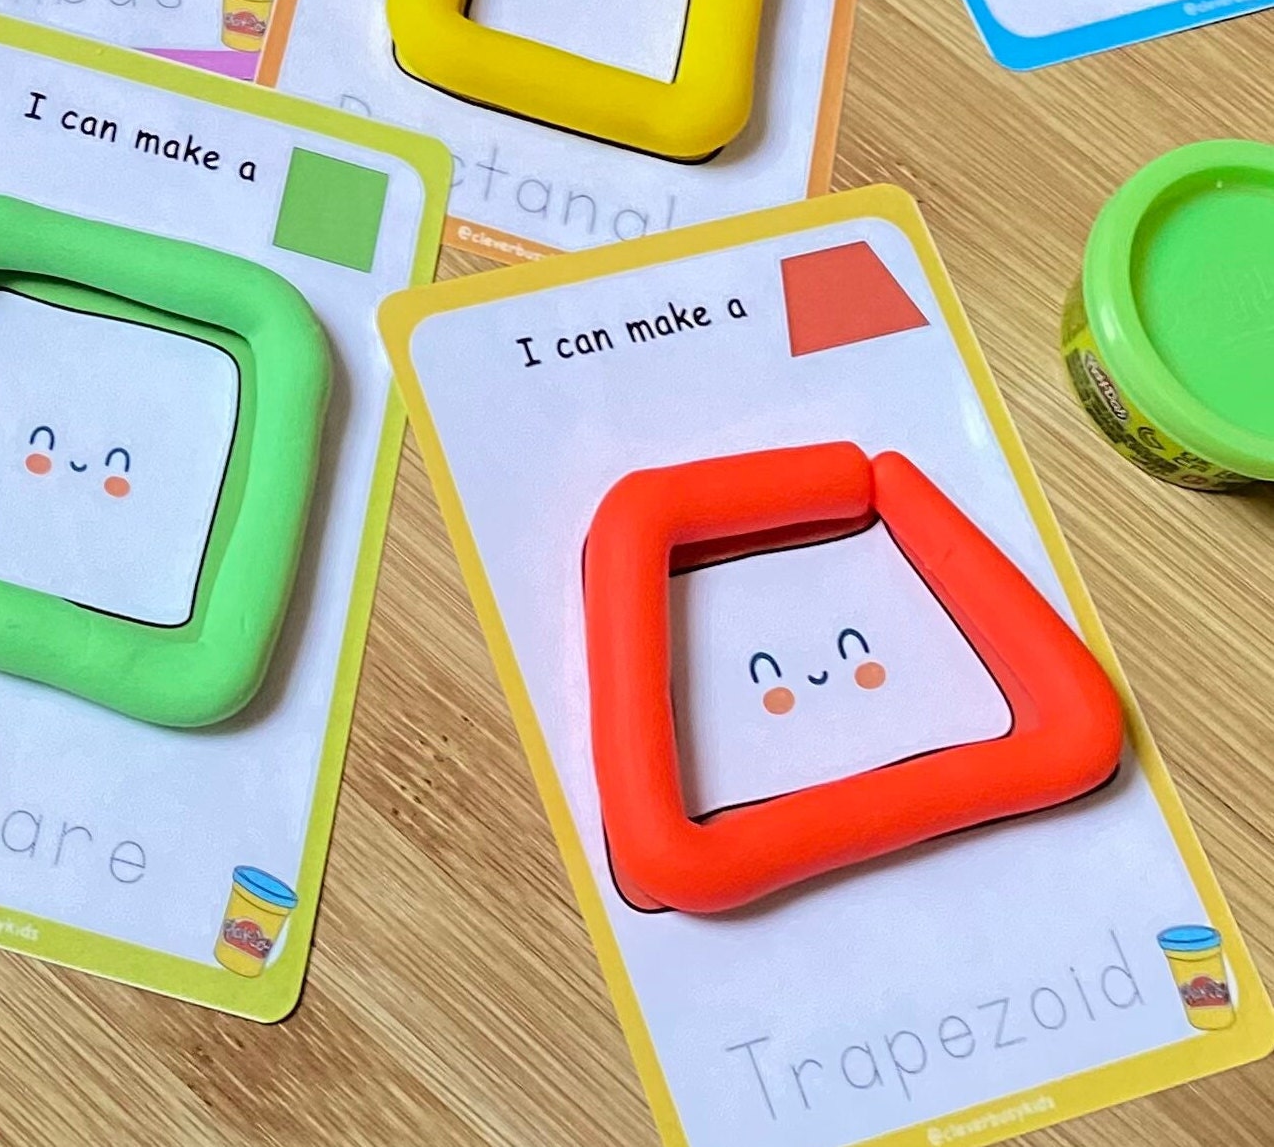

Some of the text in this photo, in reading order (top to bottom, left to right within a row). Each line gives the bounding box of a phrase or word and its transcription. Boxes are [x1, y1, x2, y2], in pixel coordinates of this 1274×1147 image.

[25, 92, 255, 181] I can make a
[517, 299, 747, 367] I can make a
[726, 929, 1145, 1120] Trapezoid
